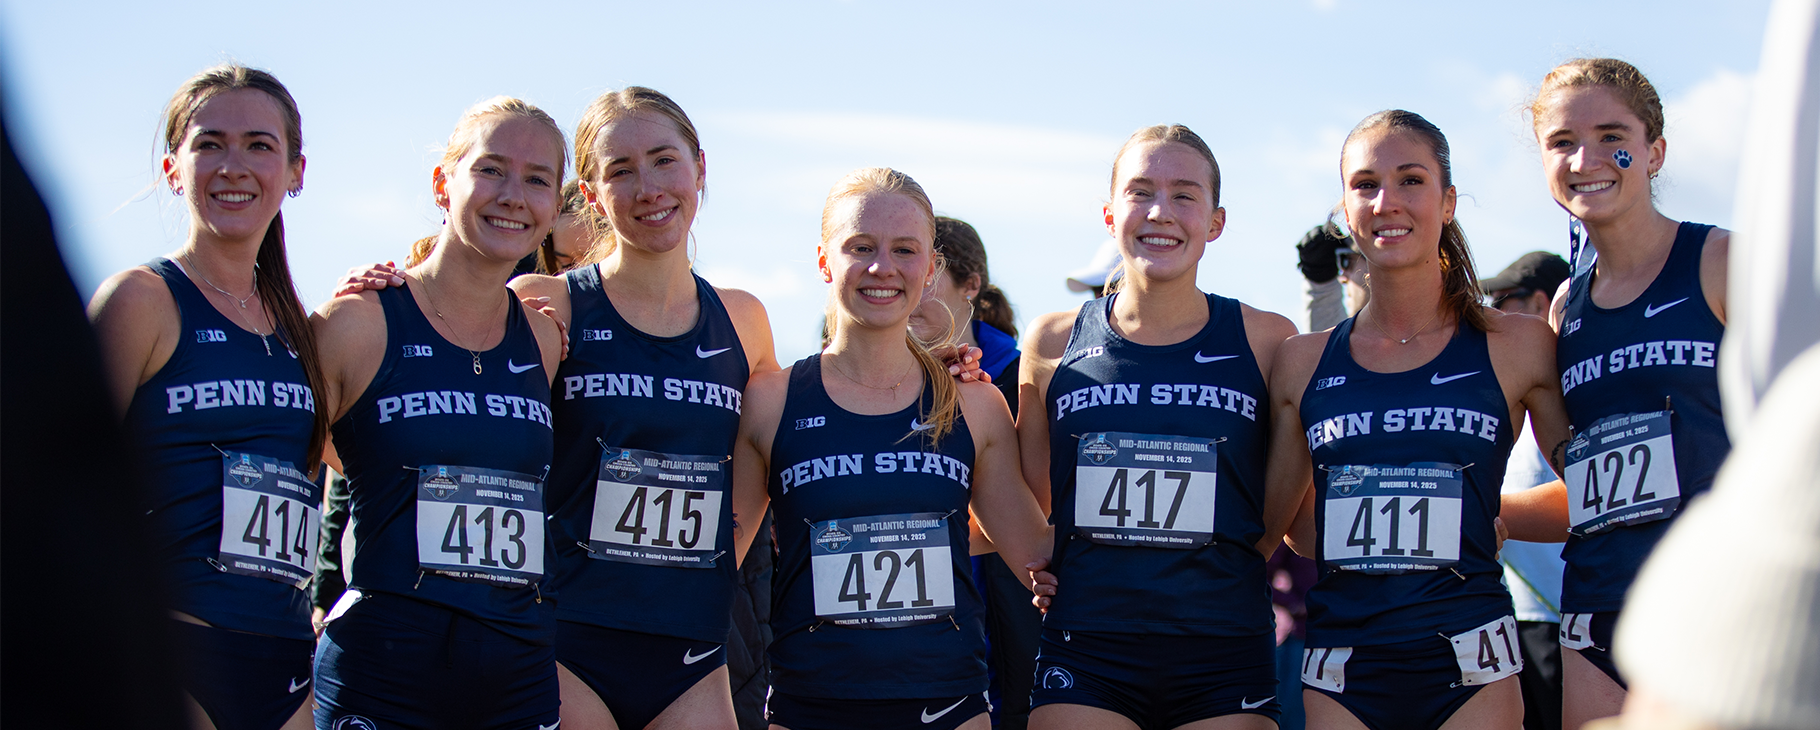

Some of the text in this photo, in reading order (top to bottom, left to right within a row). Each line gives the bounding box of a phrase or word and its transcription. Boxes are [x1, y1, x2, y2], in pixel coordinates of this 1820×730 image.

[1561, 341, 1715, 397] ENN STATE
[166, 380, 315, 414] PENN STA
[377, 390, 553, 430] PENN STAT
[564, 374, 742, 416] PENN STATE
[1056, 384, 1257, 422] PENN STATE
[1119, 440, 1172, 450] MID-ATLANTIC
[1174, 442, 1209, 452] REGIONAL
[1306, 407, 1499, 456] ENN STATE
[461, 474, 508, 487] MID-ATLANTIC
[509, 479, 536, 491] REGIONAL
[644, 458, 692, 470] MID-ATLANTIC
[694, 462, 719, 471] REGIONAL
[658, 473, 686, 482] NOVEMBER
[780, 452, 970, 495] PENN STATE
[1364, 468, 1454, 478] MID-ATLANTIC REGIONAL
[1583, 444, 1656, 515] 422
[476, 489, 503, 499] NOVEMBER
[511, 494, 524, 502] 2025
[1099, 469, 1191, 529] 417
[242, 494, 308, 567] 414
[441, 505, 526, 569] 413
[615, 487, 705, 549] 415
[853, 520, 940, 532] MID-ATLANTIC REGIONAL
[870, 535, 899, 543] NOVEMBER
[1346, 497, 1434, 557] 411
[838, 549, 933, 611] 421
[1478, 622, 1516, 673] 41
